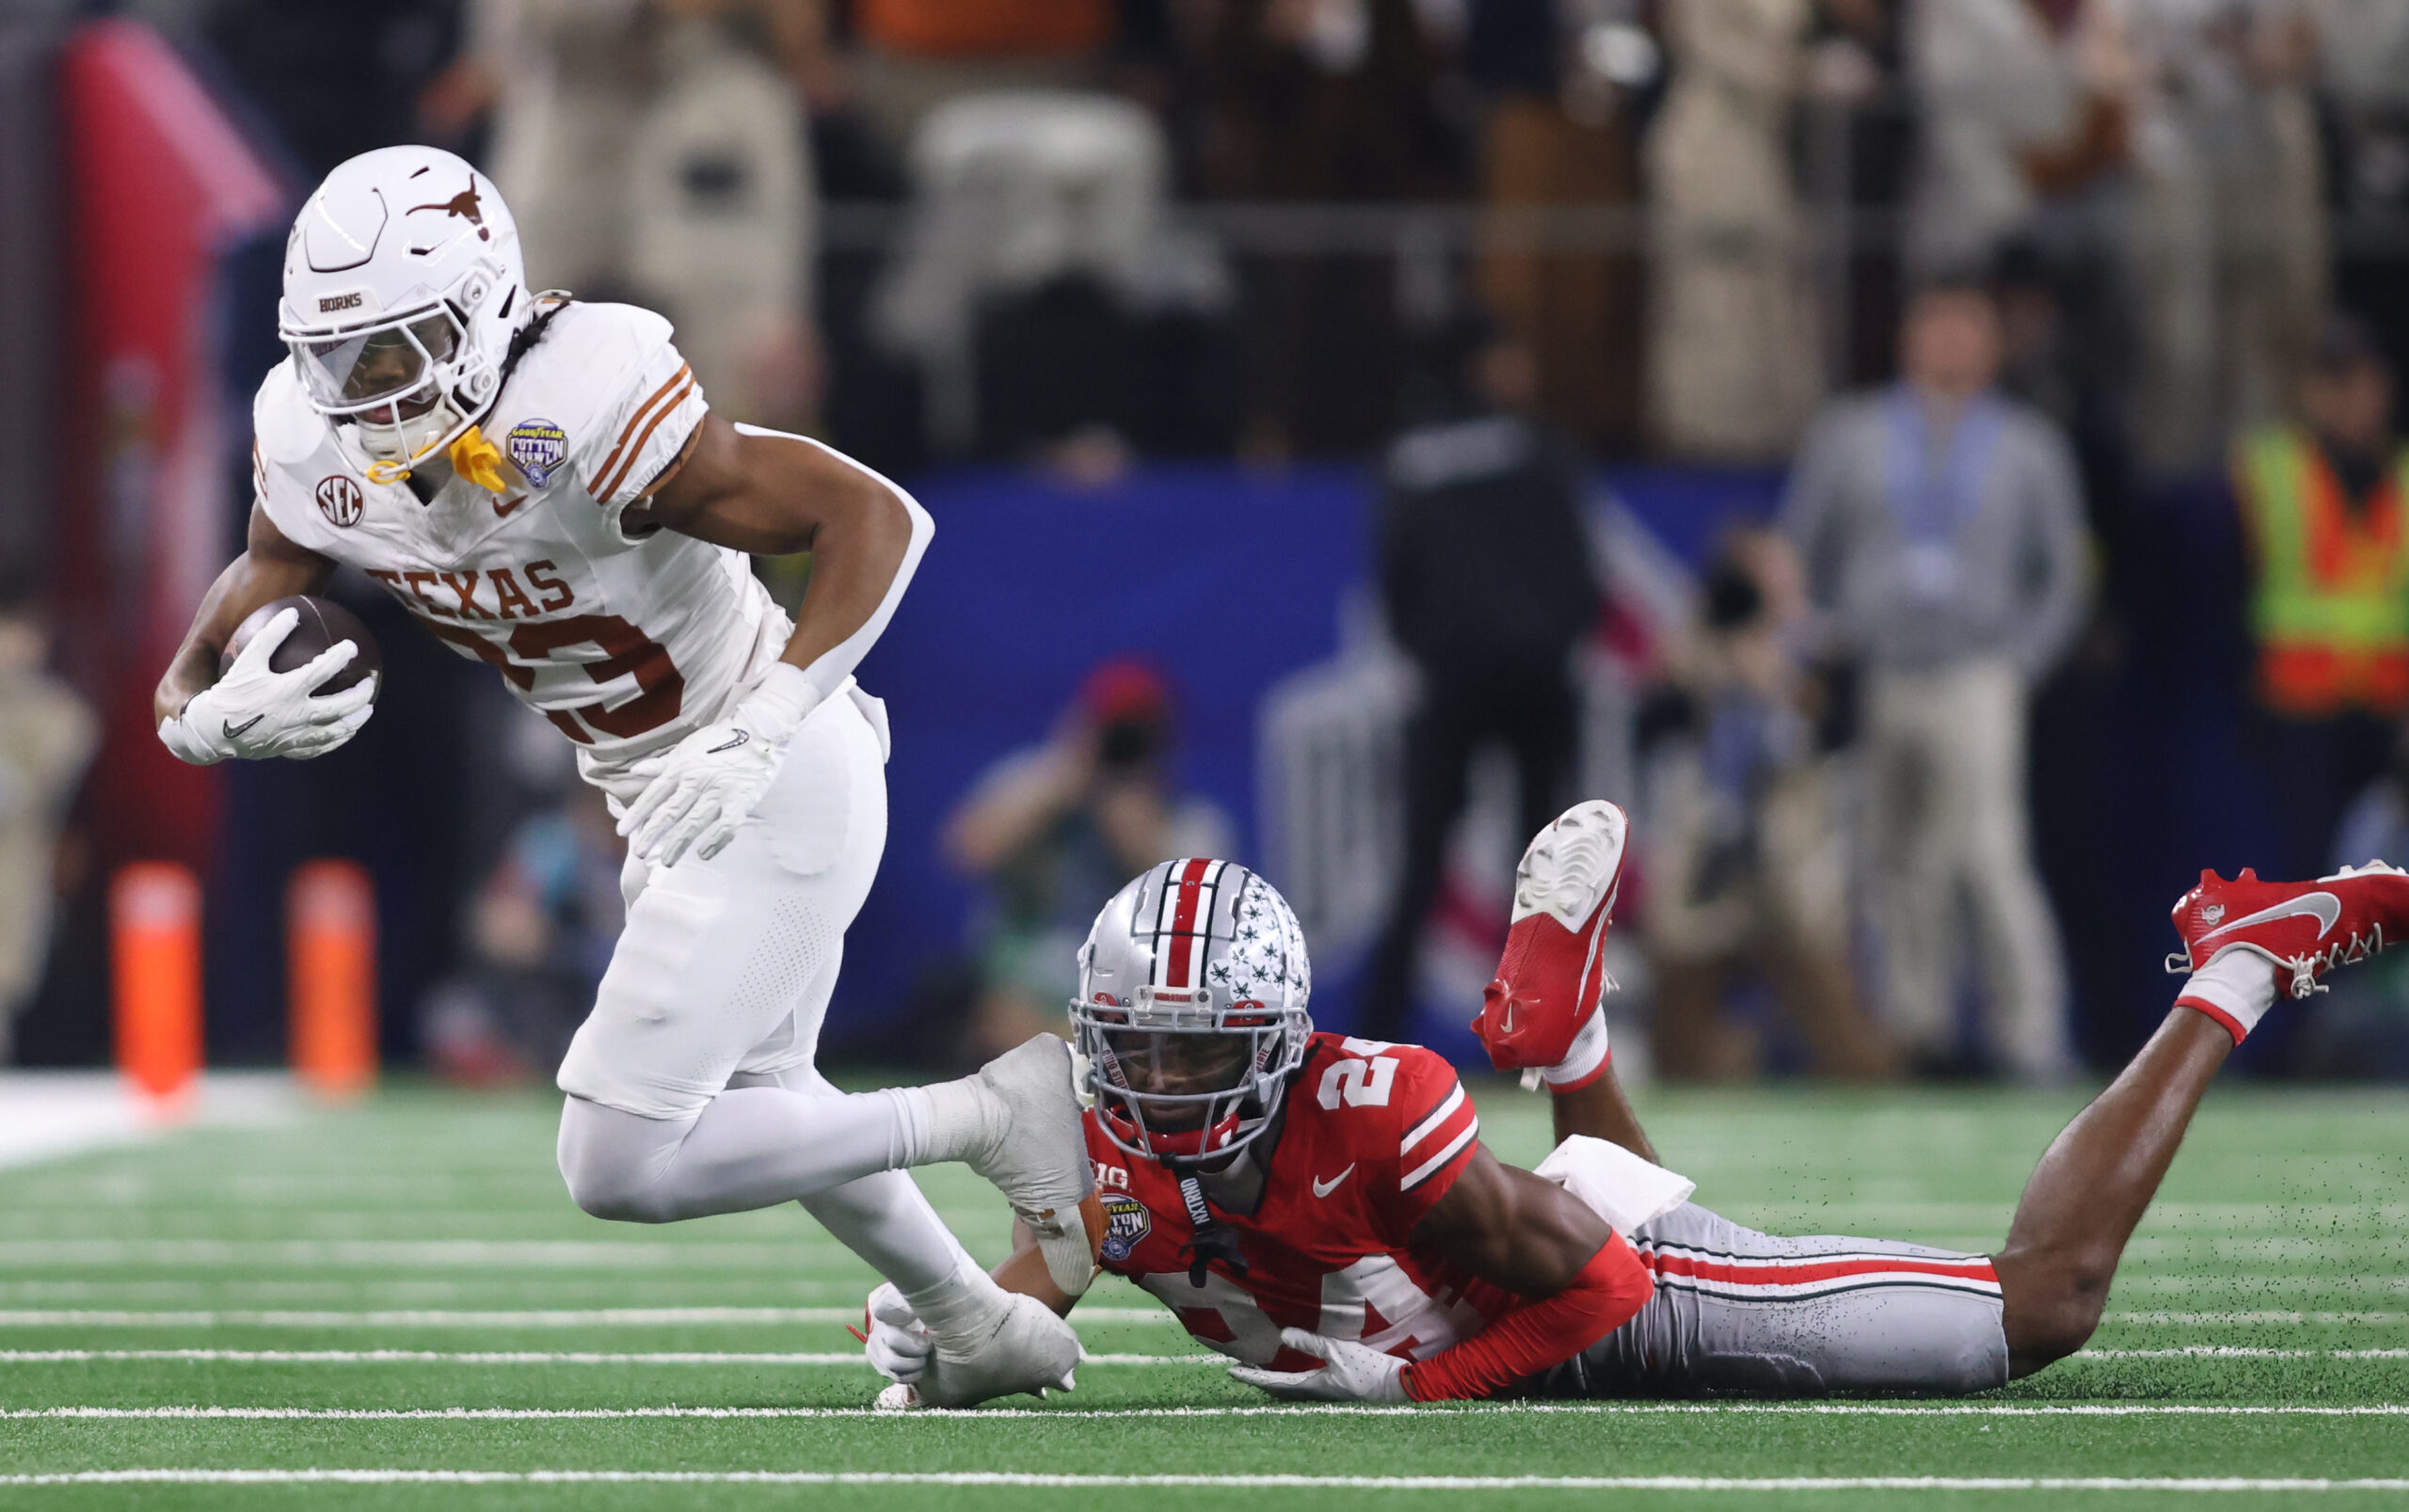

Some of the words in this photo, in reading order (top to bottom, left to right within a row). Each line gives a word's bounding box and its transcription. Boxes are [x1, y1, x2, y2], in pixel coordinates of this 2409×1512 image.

[319, 293, 362, 312] HORNS
[510, 438, 564, 462] COTTON
[318, 478, 360, 524] SEC
[1180, 1177, 1210, 1225] NXTRND
